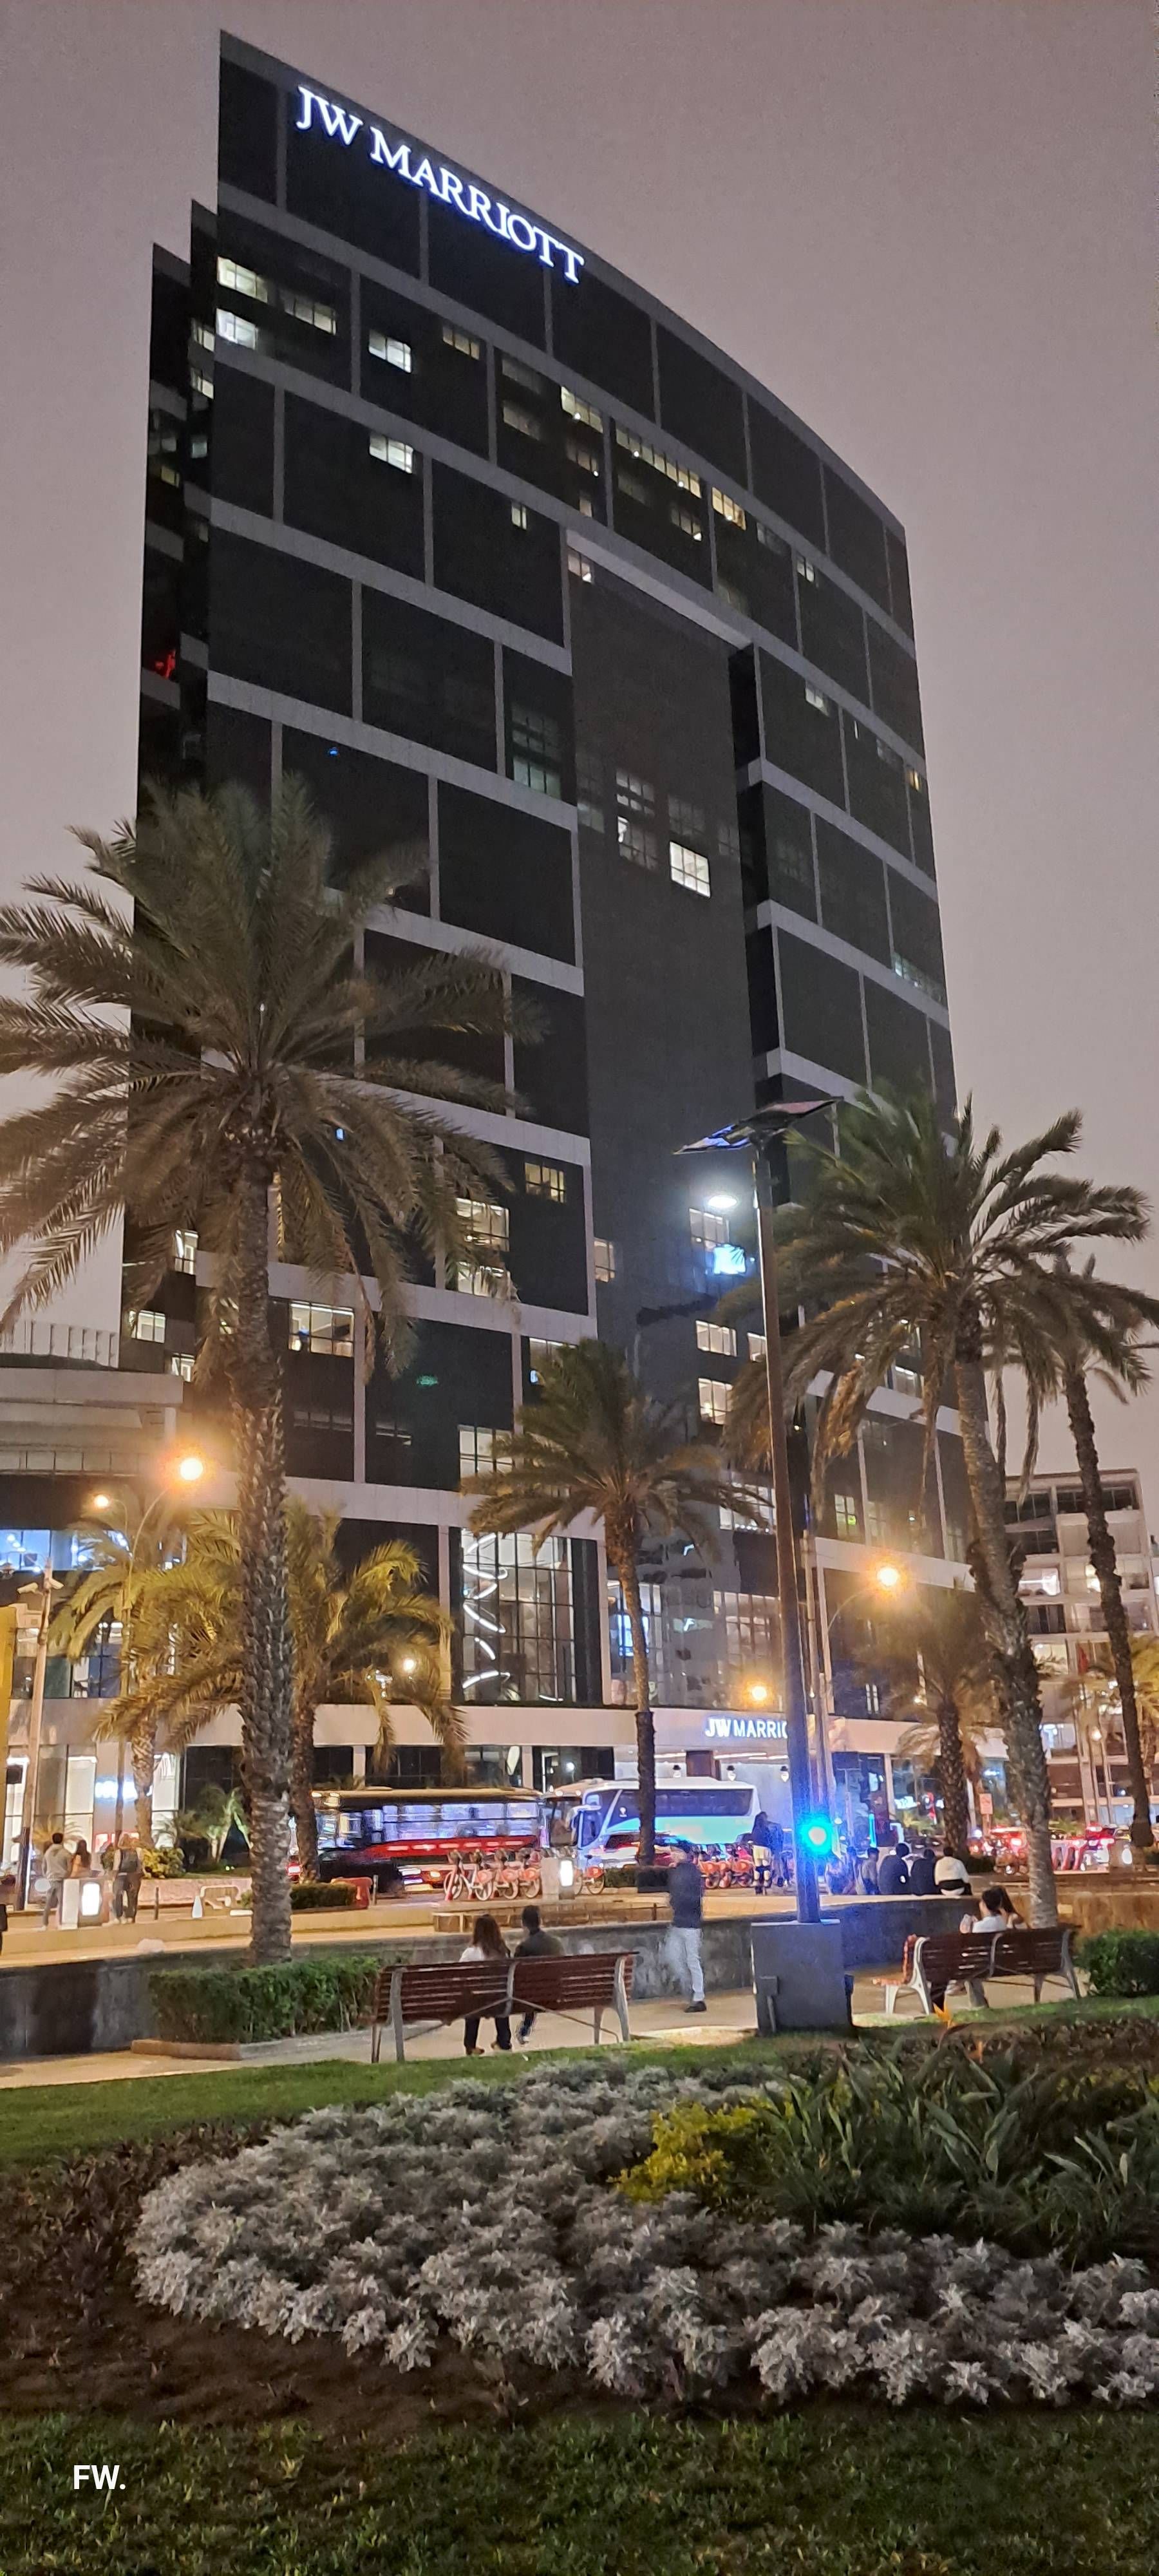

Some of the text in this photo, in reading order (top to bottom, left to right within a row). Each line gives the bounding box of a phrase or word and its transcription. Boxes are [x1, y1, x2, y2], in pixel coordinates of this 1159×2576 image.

[296, 86, 585, 284] JW MARRIOTT
[705, 1718, 731, 1738] JW
